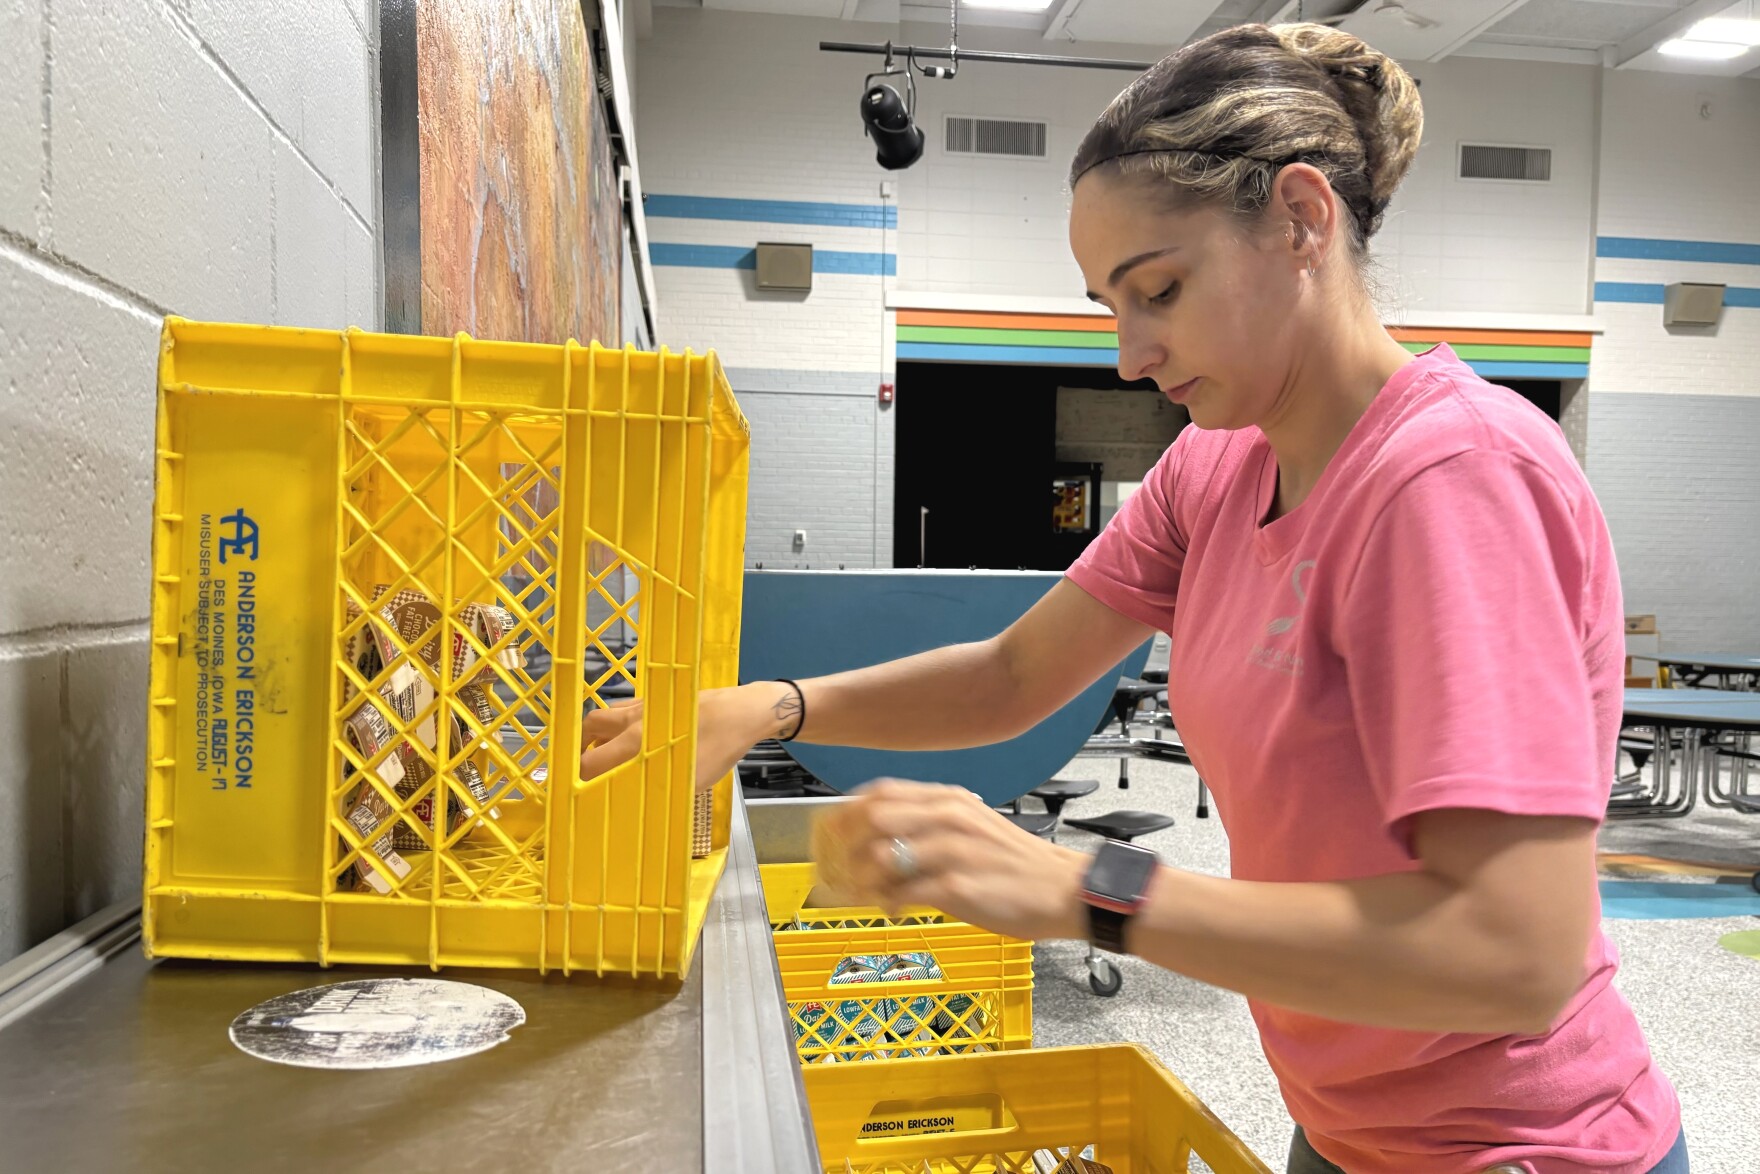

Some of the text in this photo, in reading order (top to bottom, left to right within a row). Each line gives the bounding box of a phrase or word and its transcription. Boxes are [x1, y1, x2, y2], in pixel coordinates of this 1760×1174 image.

[213, 580, 225, 606] DES
[402, 606, 416, 640] FAT FREE
[197, 514, 211, 771] MISUSER SUBJECT TO PROSECUTION
[212, 675, 224, 714] IOWA
[235, 571, 256, 788] ANDERSON ERICKSON
[861, 1117, 954, 1133] NDERSON ERICKSON
